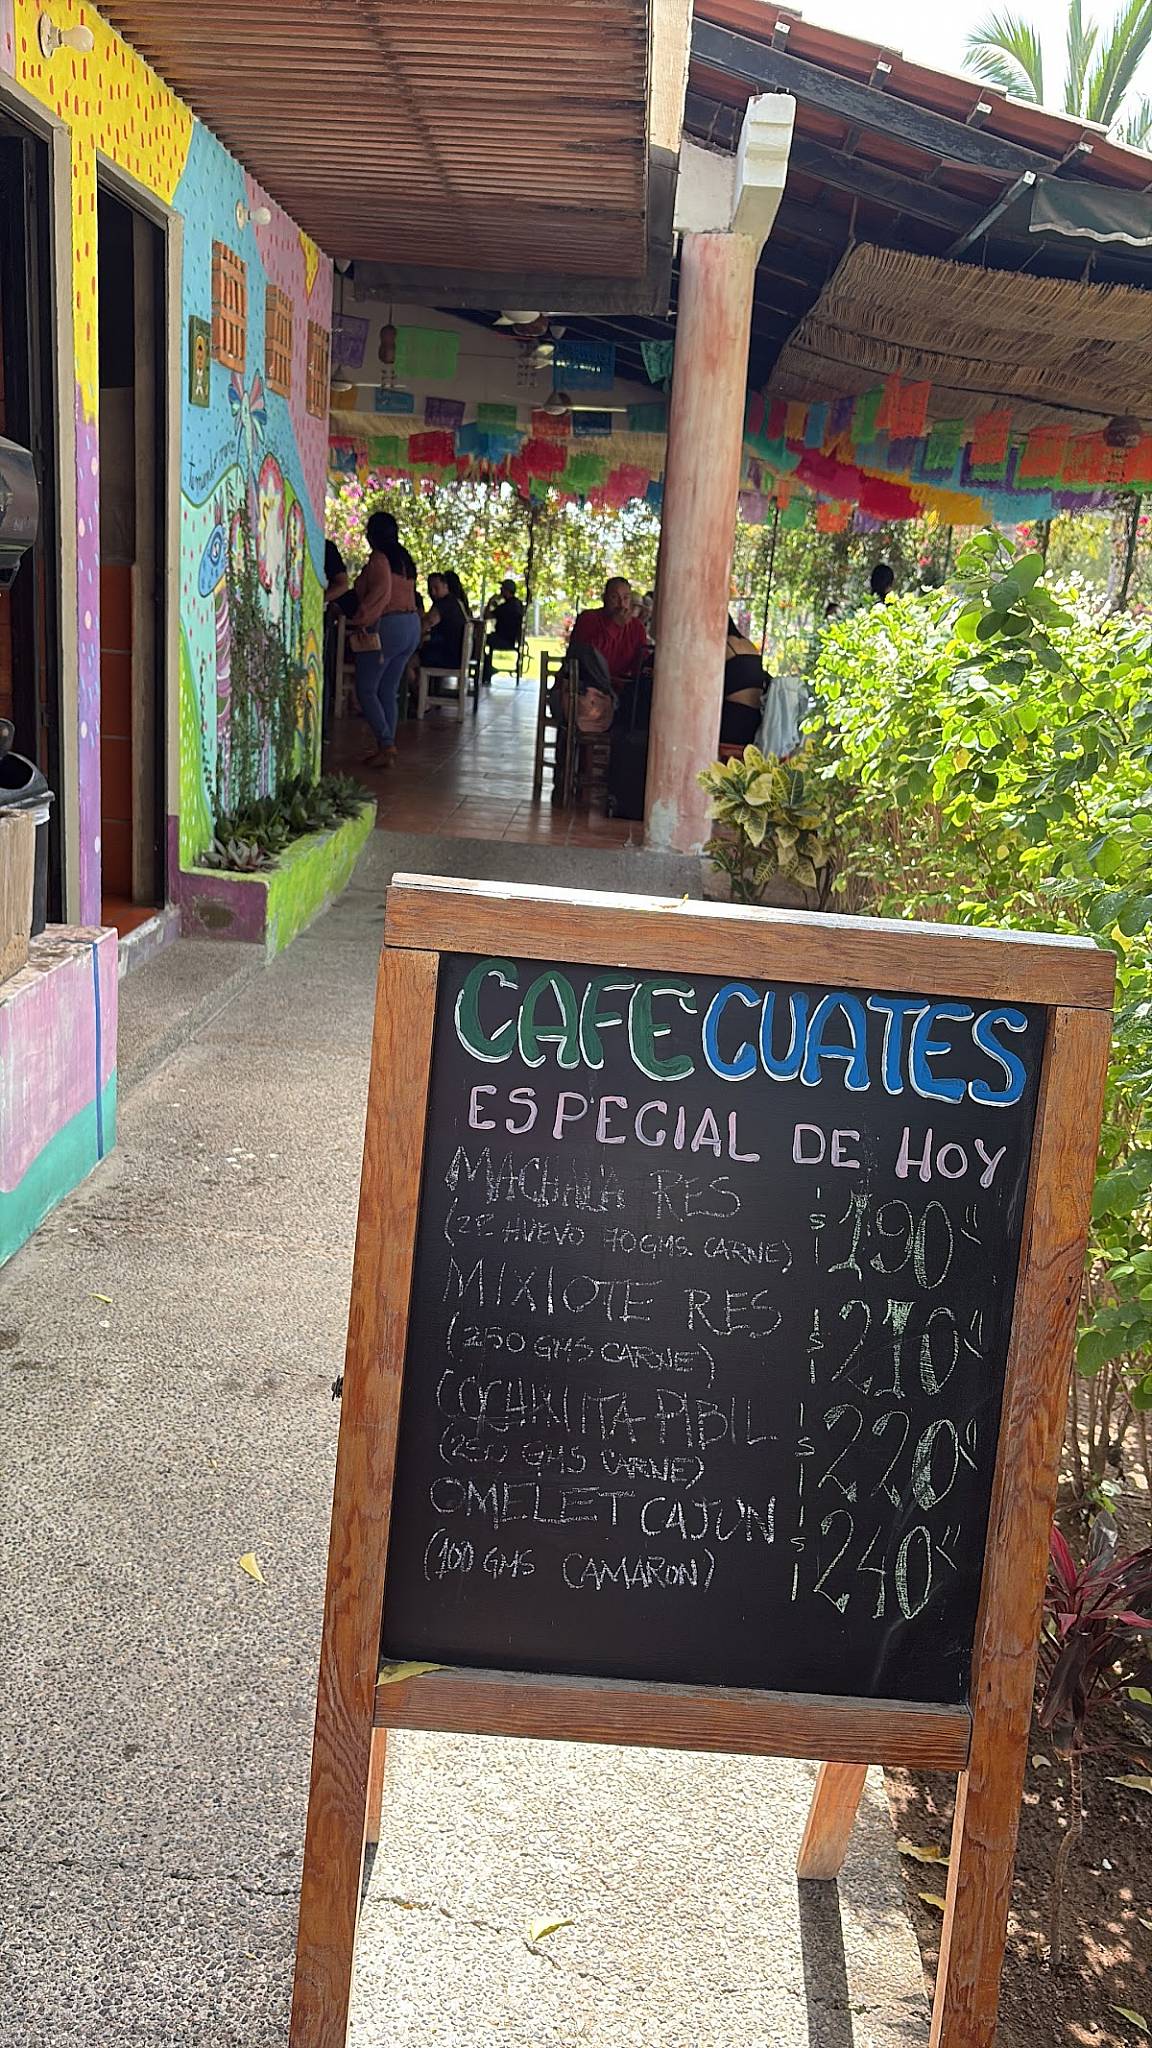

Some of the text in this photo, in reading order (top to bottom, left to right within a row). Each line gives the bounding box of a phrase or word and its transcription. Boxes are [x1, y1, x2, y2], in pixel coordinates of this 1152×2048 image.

[702, 982, 1028, 1107] CUATES
[468, 1085, 1007, 1188] ESPECIAL DE HOY
[650, 1170, 741, 1222] RES
[501, 1215, 585, 1246] HUEVO
[443, 1255, 783, 1338] MIXIOTE RES
[654, 1388, 779, 1449] PIBIL
[430, 1477, 777, 1544] OMELET CAJUN
[561, 1548, 715, 1592] CAMARON)
